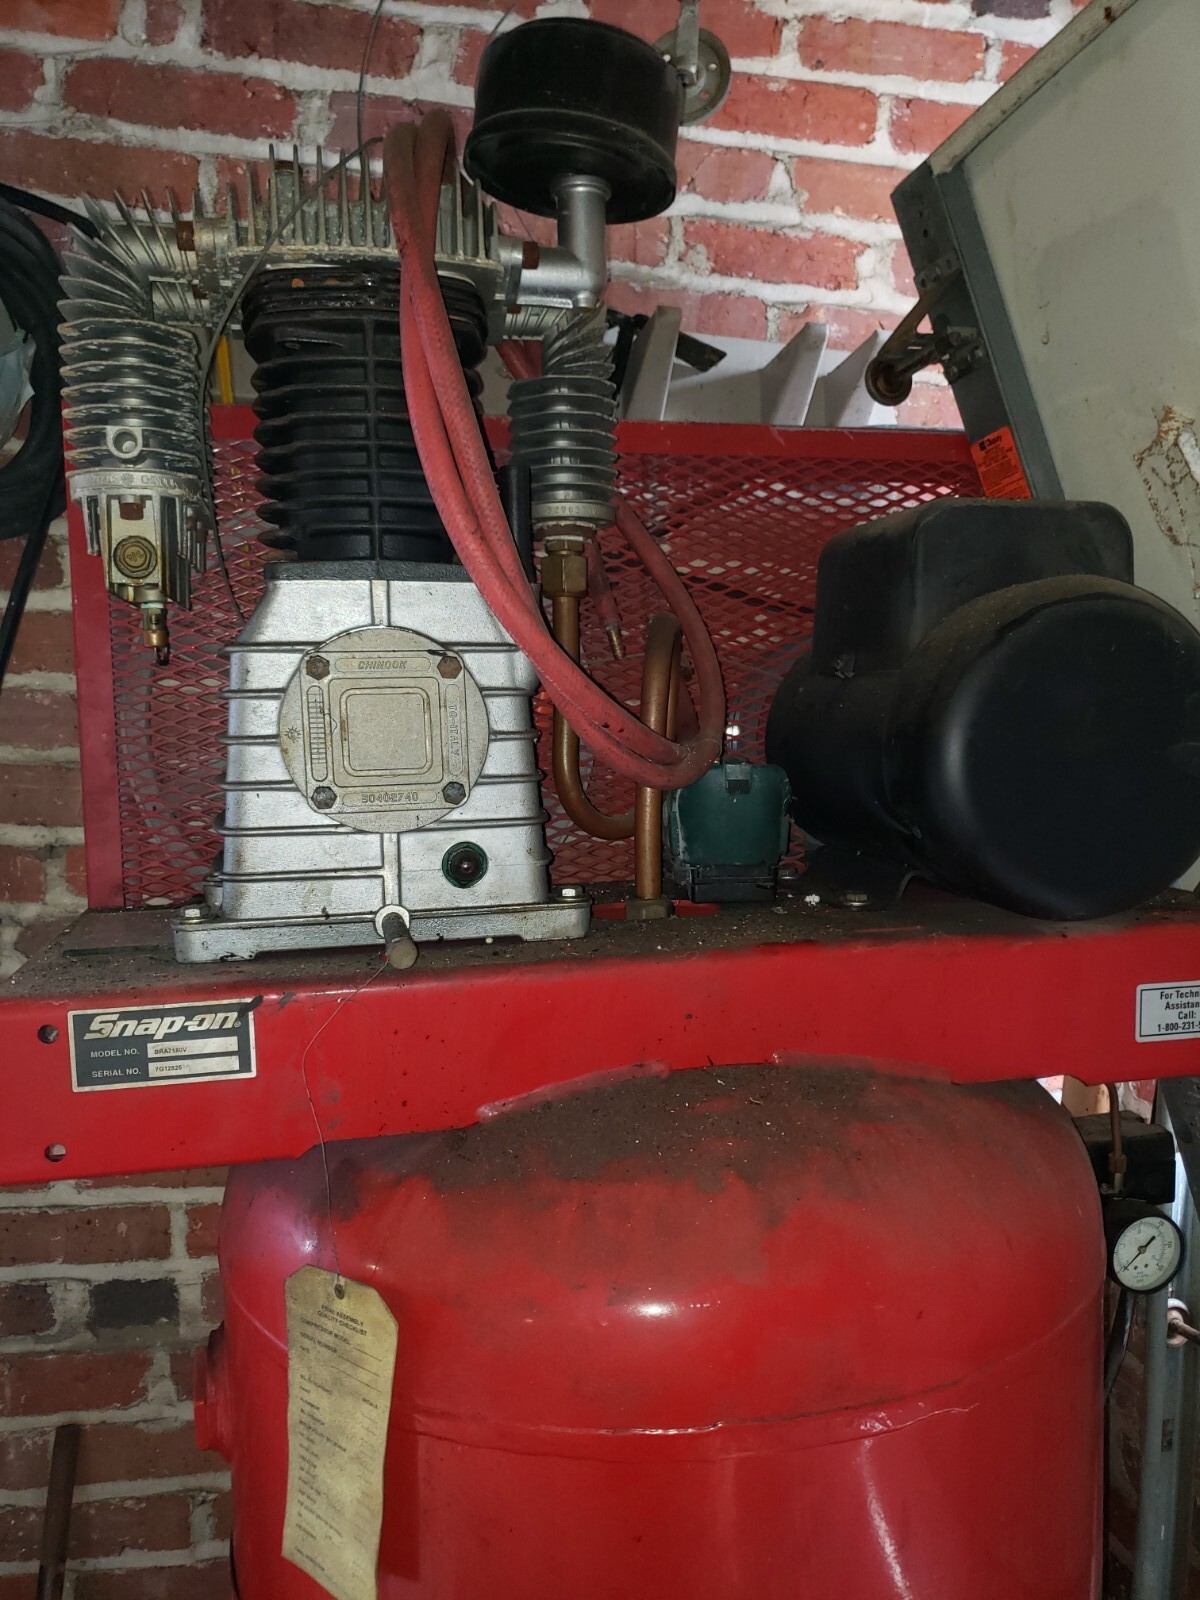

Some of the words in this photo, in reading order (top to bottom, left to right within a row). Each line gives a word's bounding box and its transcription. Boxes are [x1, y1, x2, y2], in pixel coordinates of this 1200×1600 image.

[357, 660, 408, 670] CHINOOK
[1160, 991, 1173, 1000] For
[1178, 1010, 1197, 1020] Call:
[83, 1012, 238, 1040] Snap-on
[90, 1049, 122, 1058] MODEL
[124, 1048, 140, 1056] NO.
[91, 1069, 124, 1078] SERIAL
[126, 1067, 142, 1075] NO.
